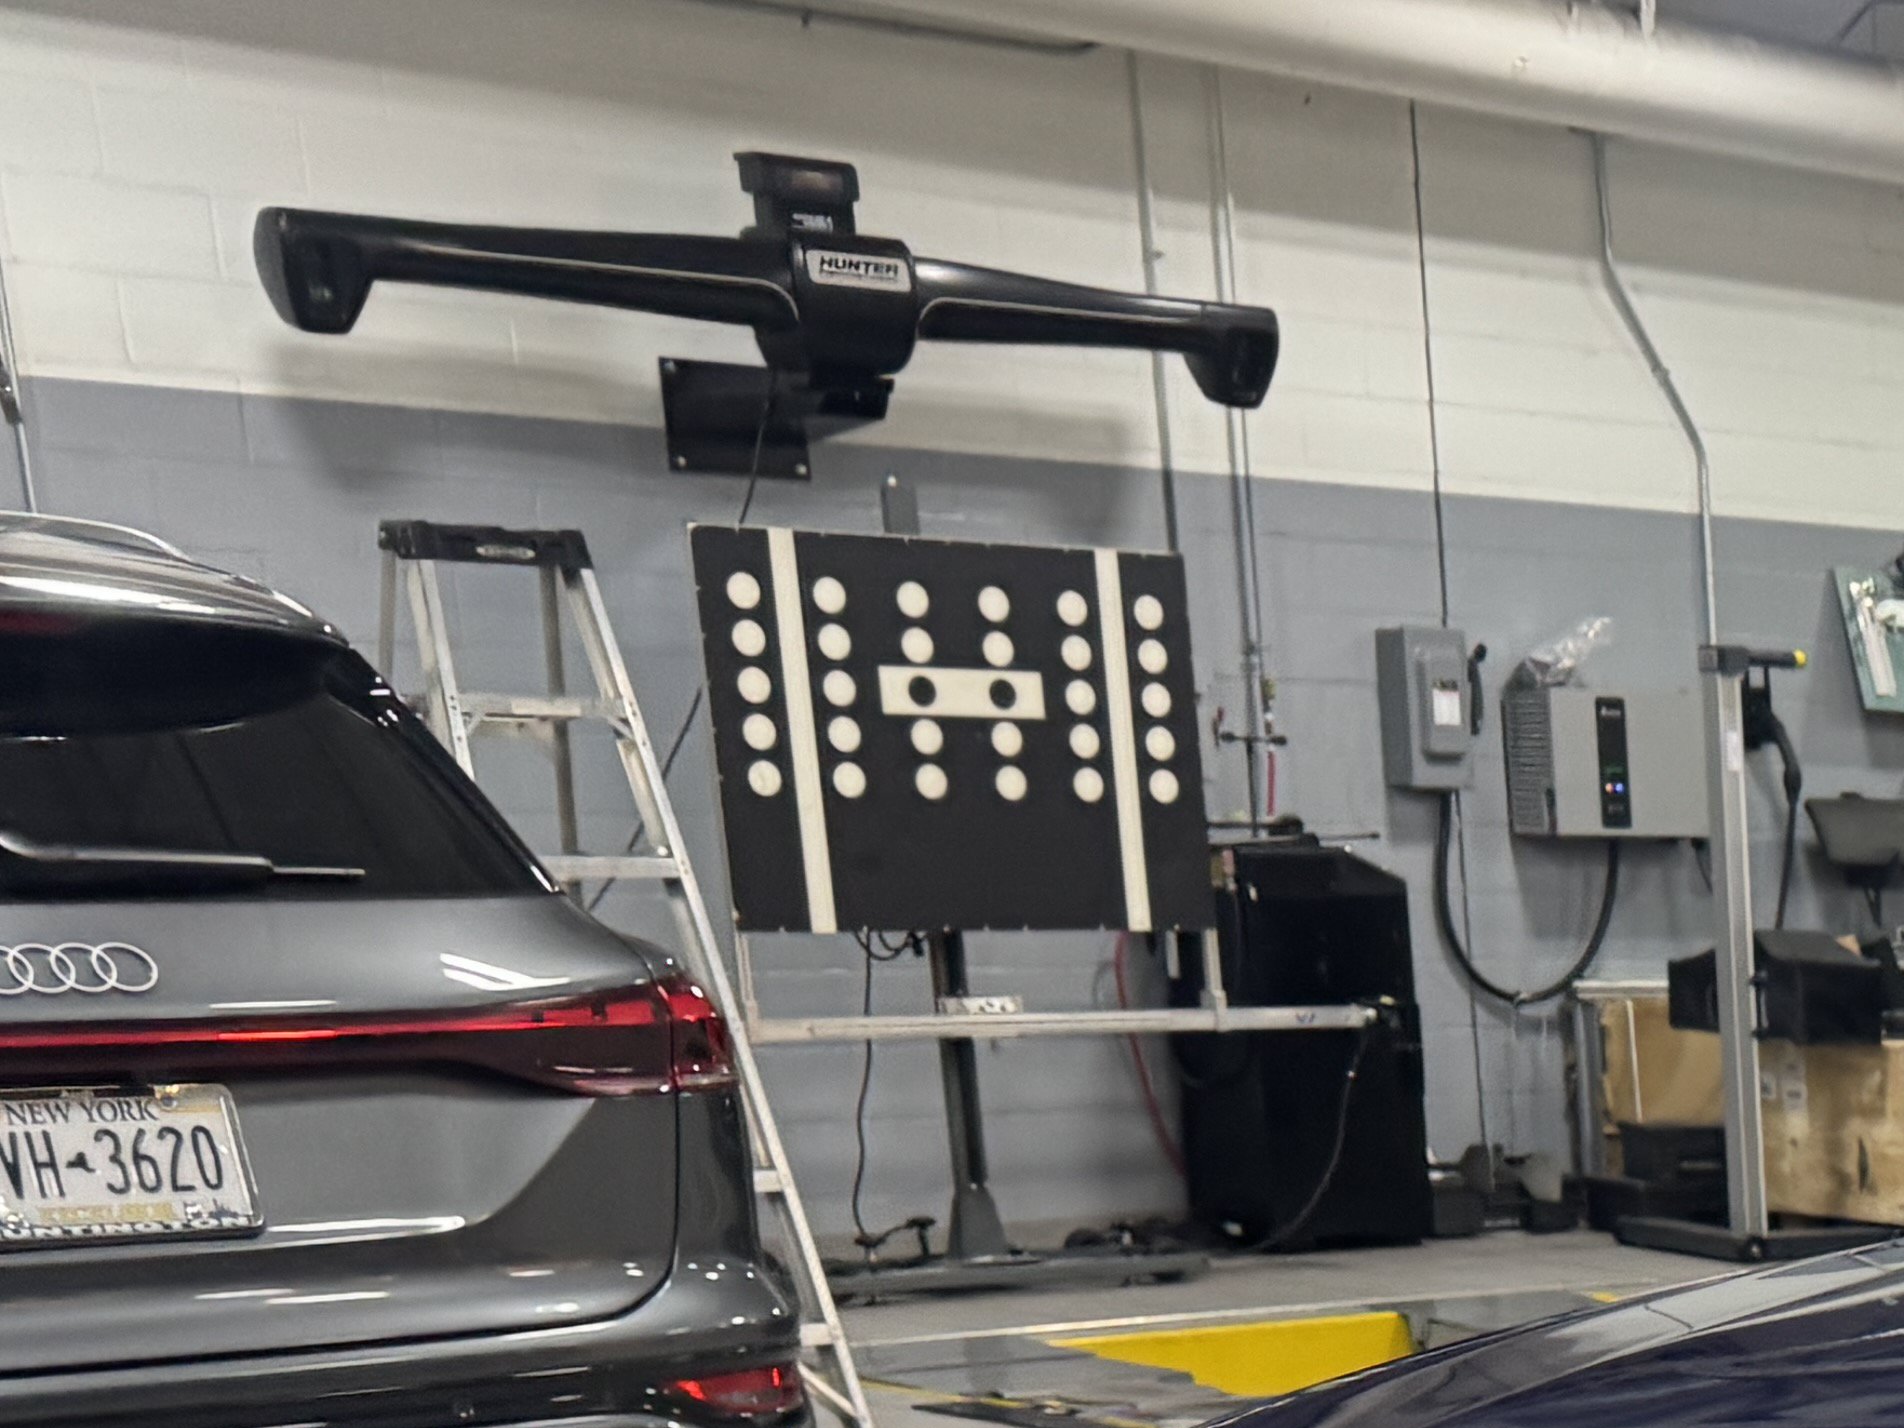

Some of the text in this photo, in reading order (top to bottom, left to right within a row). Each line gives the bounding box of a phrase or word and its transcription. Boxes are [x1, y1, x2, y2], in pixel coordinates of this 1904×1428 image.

[820, 255, 899, 275] HUNTER
[4, 1098, 160, 1126] NEW YORK
[0, 1216, 251, 1240] UNTINGTON
